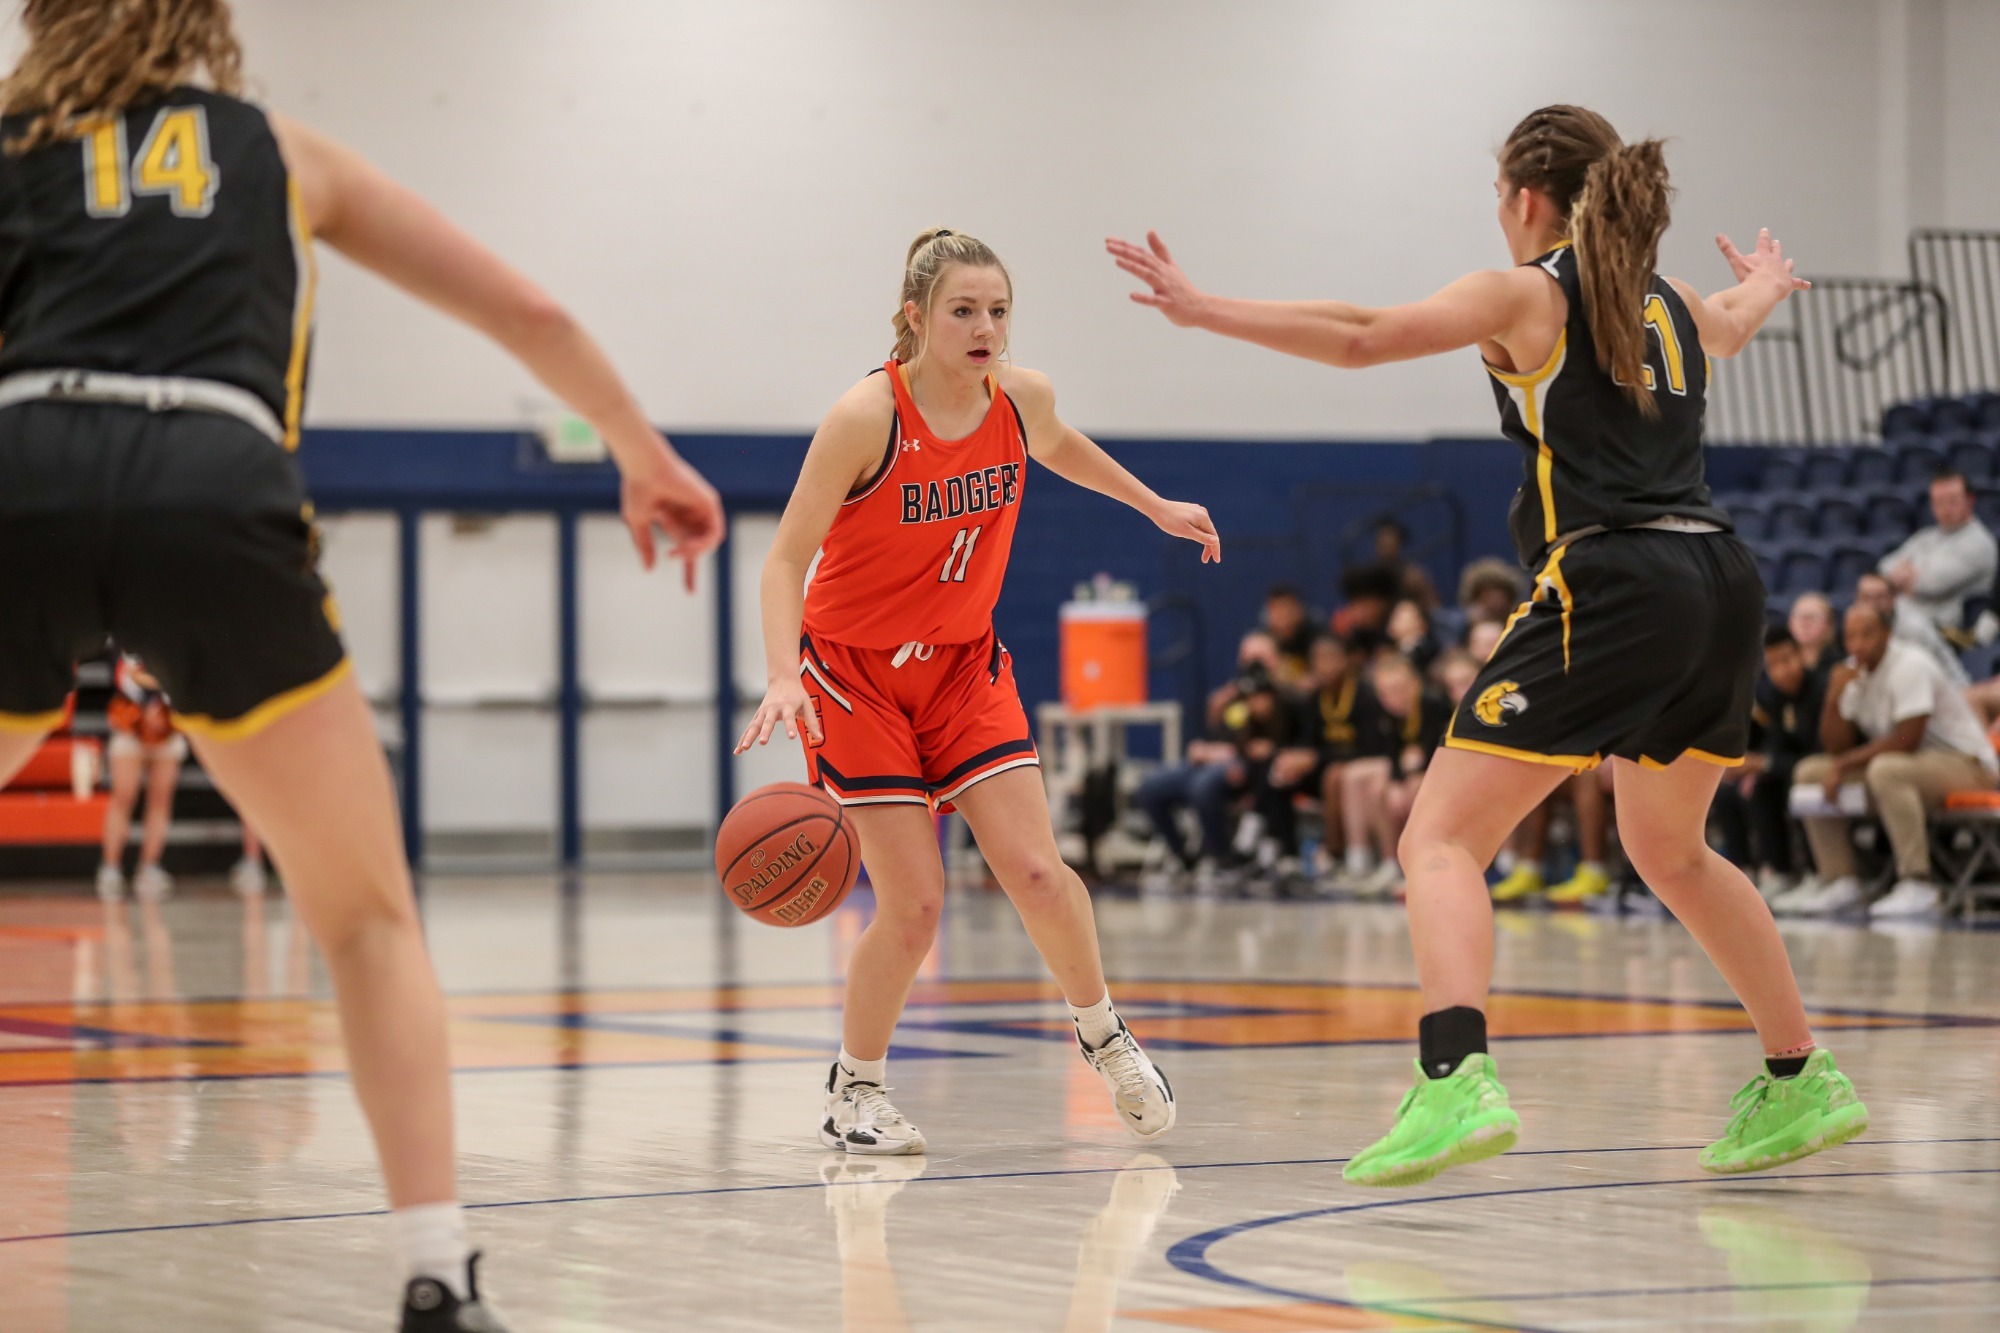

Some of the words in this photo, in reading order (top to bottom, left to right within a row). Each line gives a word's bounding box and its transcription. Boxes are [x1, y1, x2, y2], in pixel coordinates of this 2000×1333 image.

[76, 104, 220, 219] 14
[938, 525, 983, 582] 11
[733, 832, 817, 906] SPALDING
[771, 875, 828, 926] NJCAA
